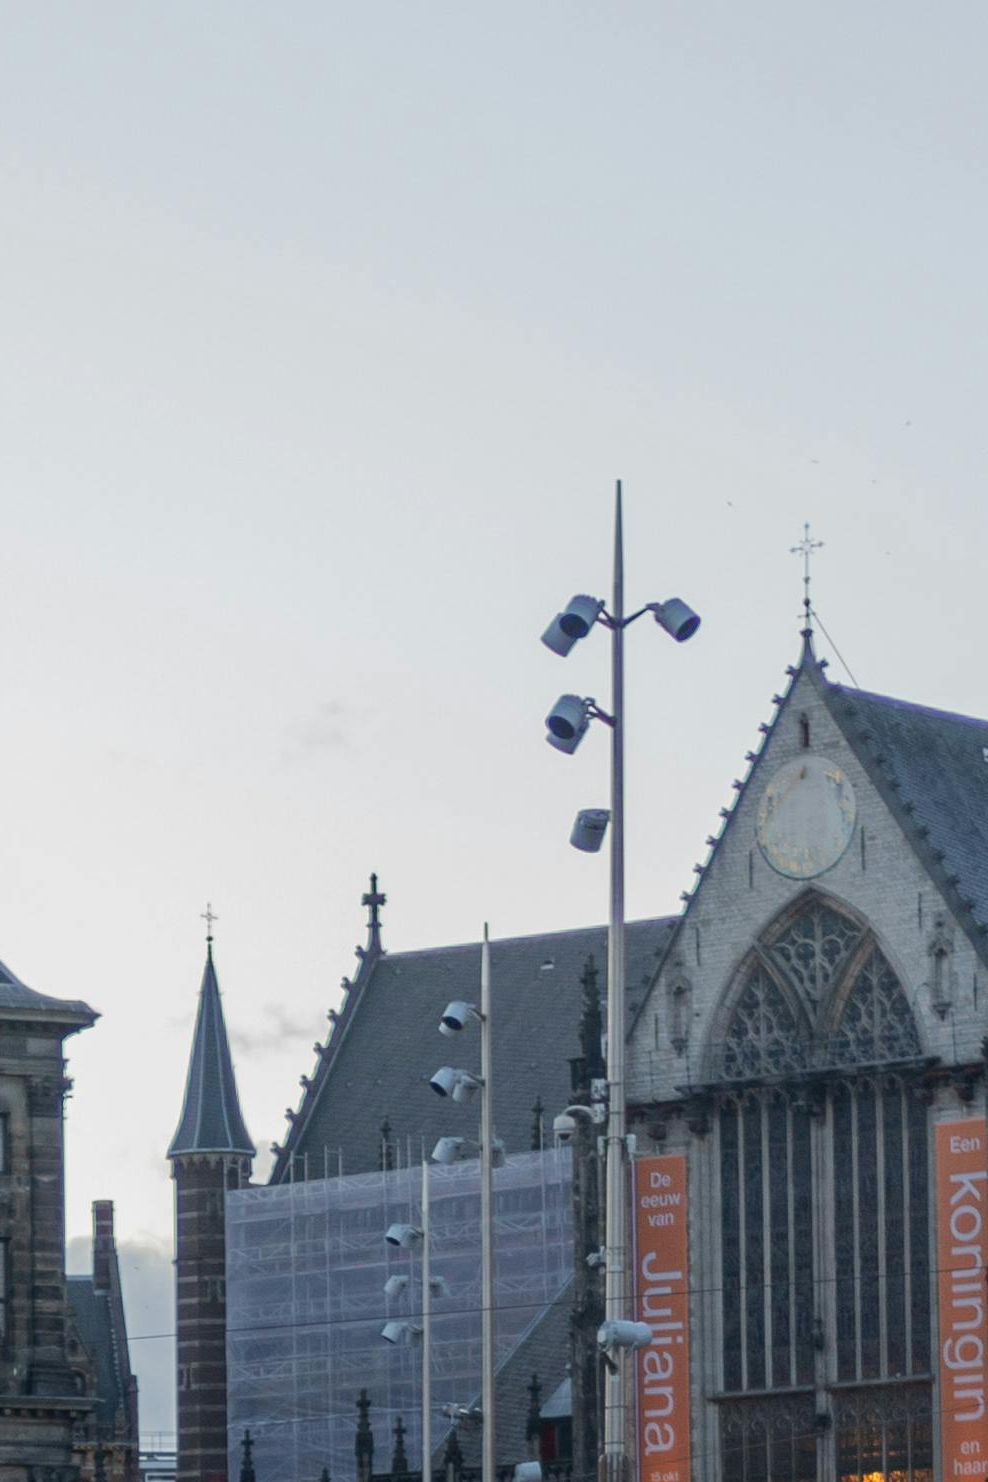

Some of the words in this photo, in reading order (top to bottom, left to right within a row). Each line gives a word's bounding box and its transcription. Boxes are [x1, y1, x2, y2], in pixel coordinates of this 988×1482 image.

[950, 1135, 981, 1153] Een
[650, 1172, 671, 1188] De
[641, 1192, 681, 1208] eeuw
[648, 1212, 675, 1228] van
[642, 1251, 684, 1457] Juliana
[960, 1441, 980, 1454] en
[954, 1459, 988, 1475] haar
